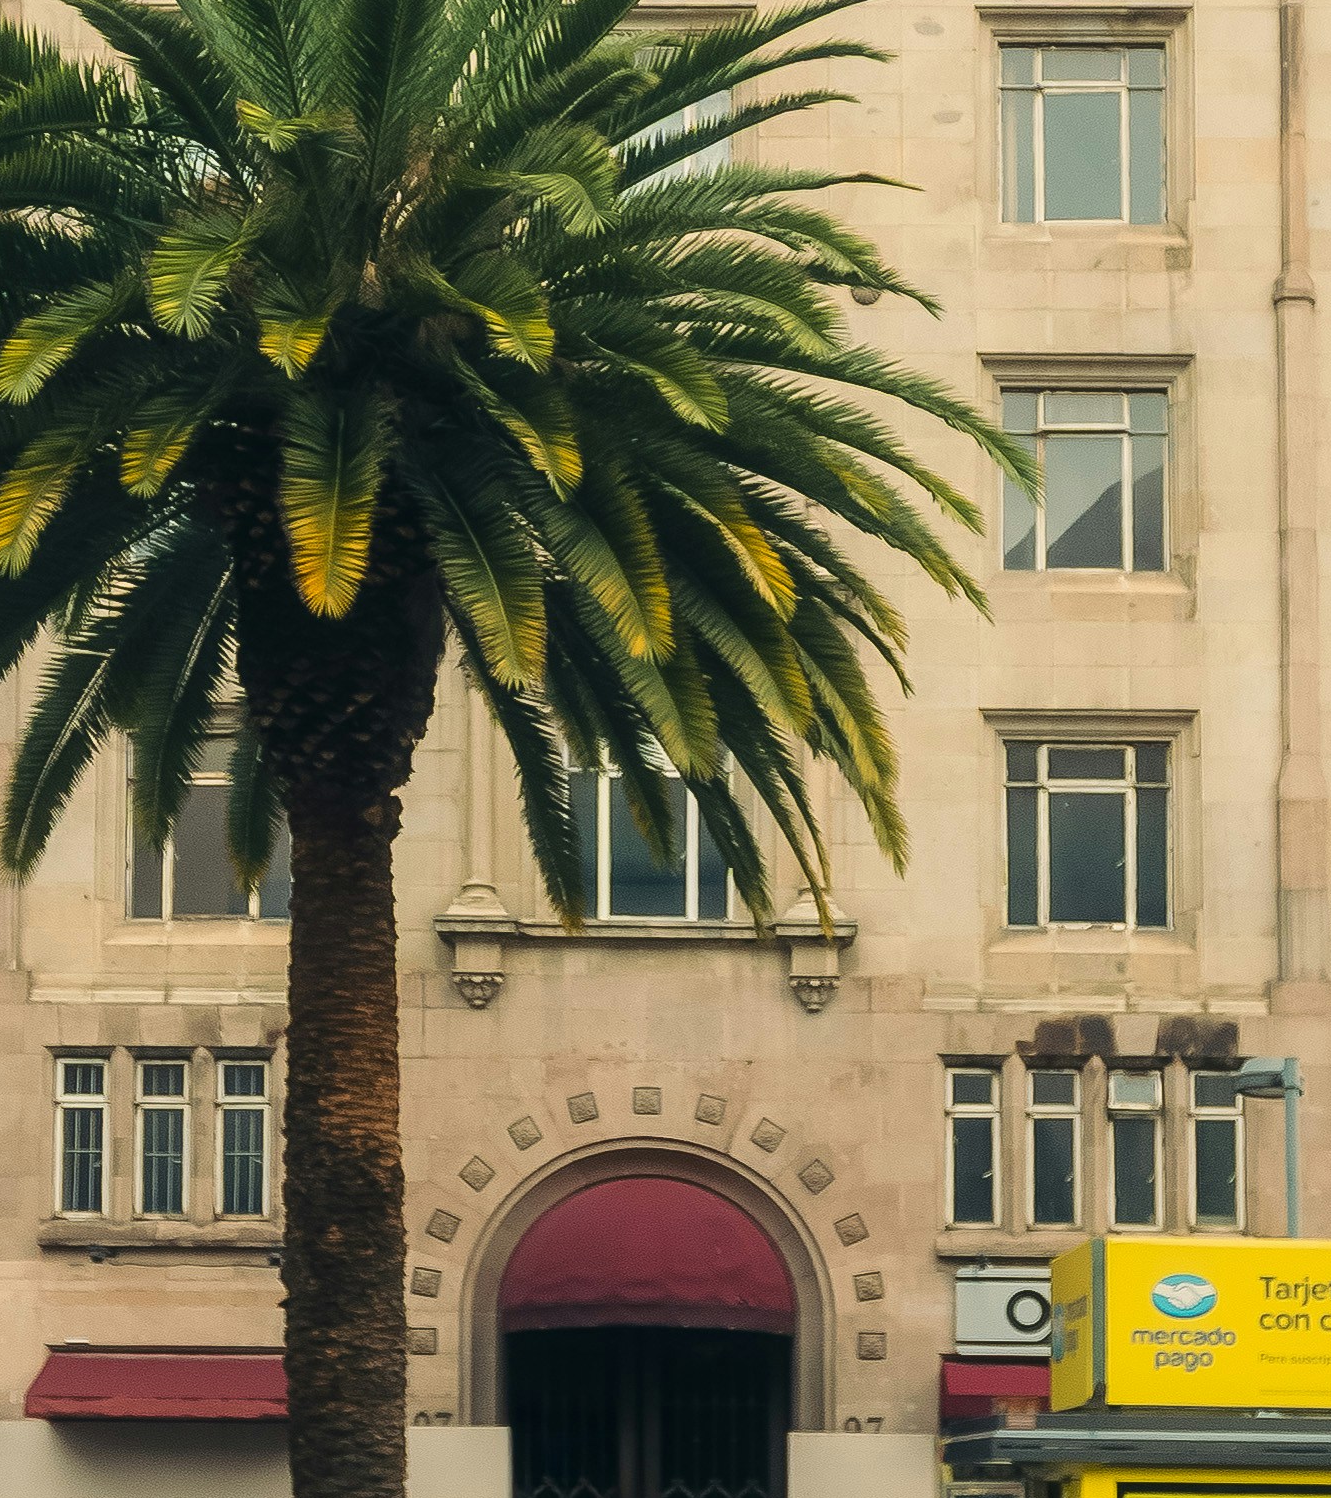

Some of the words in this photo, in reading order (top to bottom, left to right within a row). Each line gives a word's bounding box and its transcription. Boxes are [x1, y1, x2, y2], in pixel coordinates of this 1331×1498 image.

[1260, 1313, 1310, 1332] con
[1131, 1328, 1236, 1346] mercado
[1155, 1350, 1214, 1372] pago
